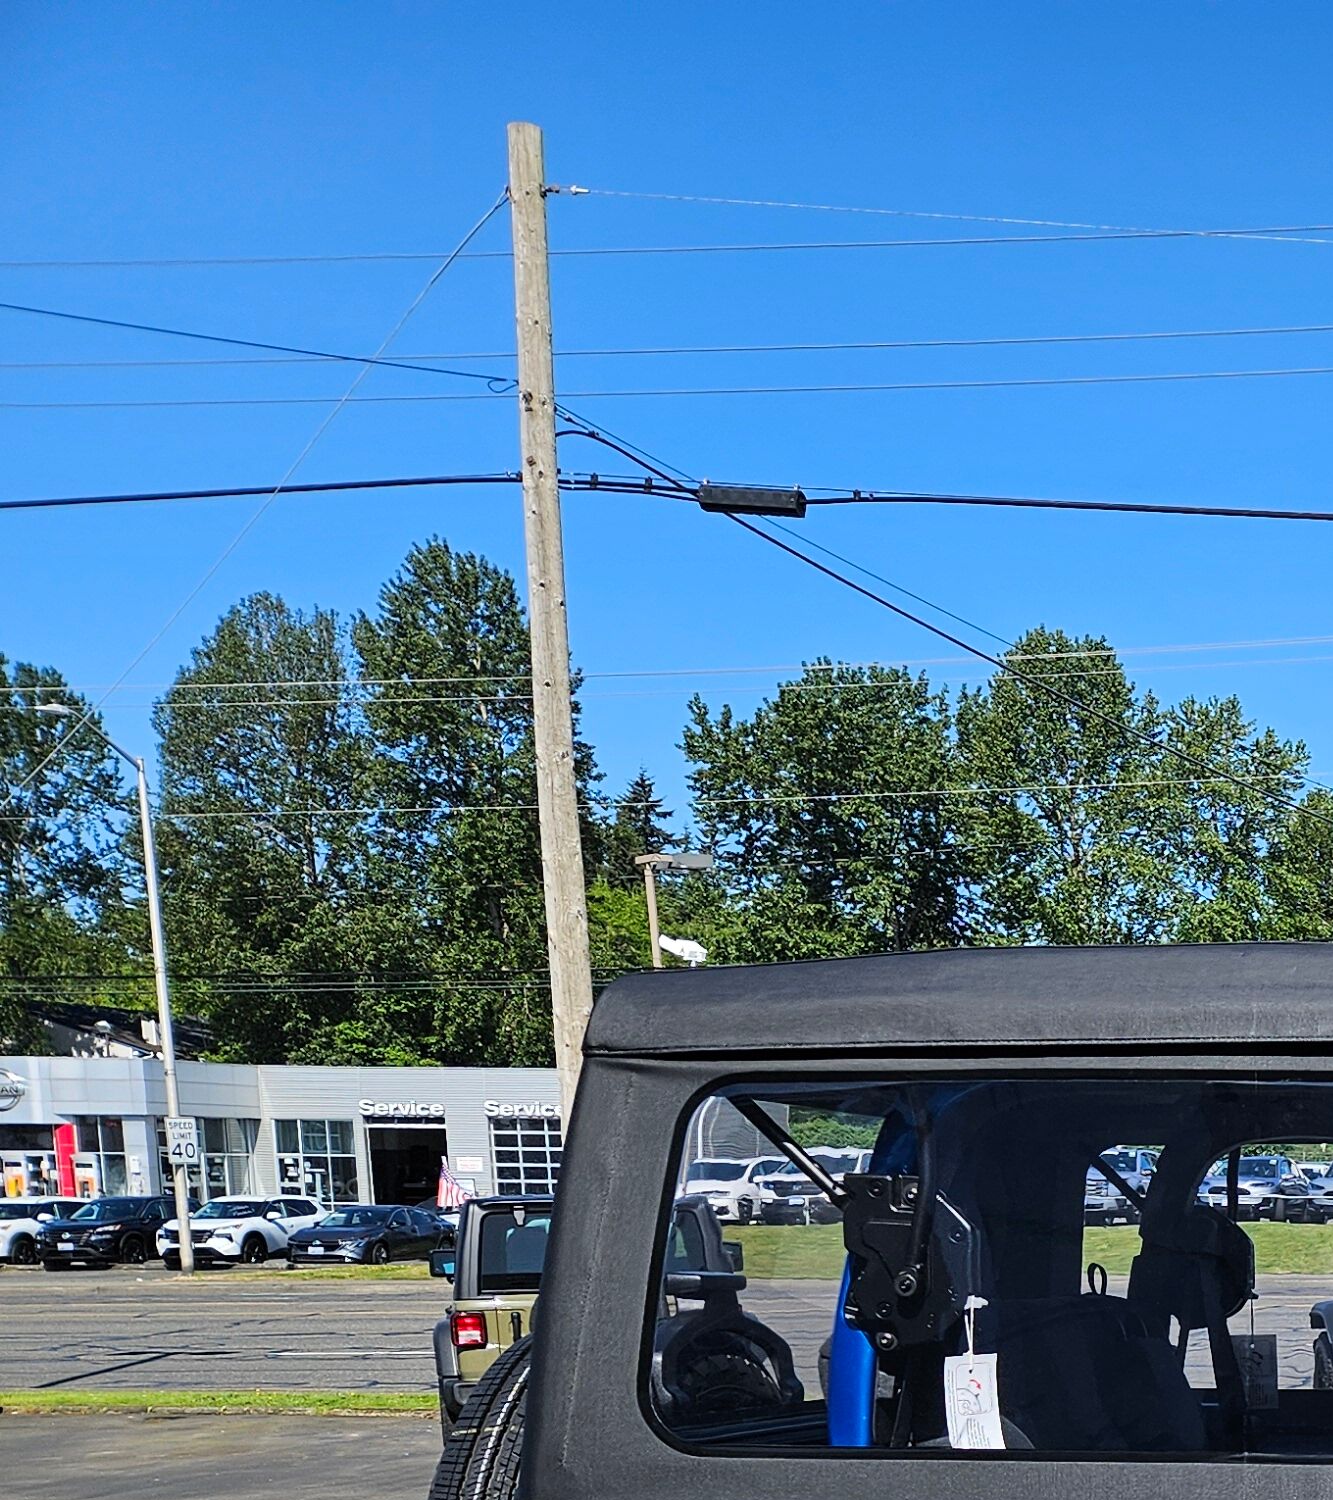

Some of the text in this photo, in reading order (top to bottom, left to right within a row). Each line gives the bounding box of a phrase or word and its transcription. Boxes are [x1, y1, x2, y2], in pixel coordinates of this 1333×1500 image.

[358, 1098, 445, 1118] Service
[168, 1121, 193, 1130] SPEED
[172, 1131, 192, 1140] LIMIT
[171, 1142, 196, 1159] 40
